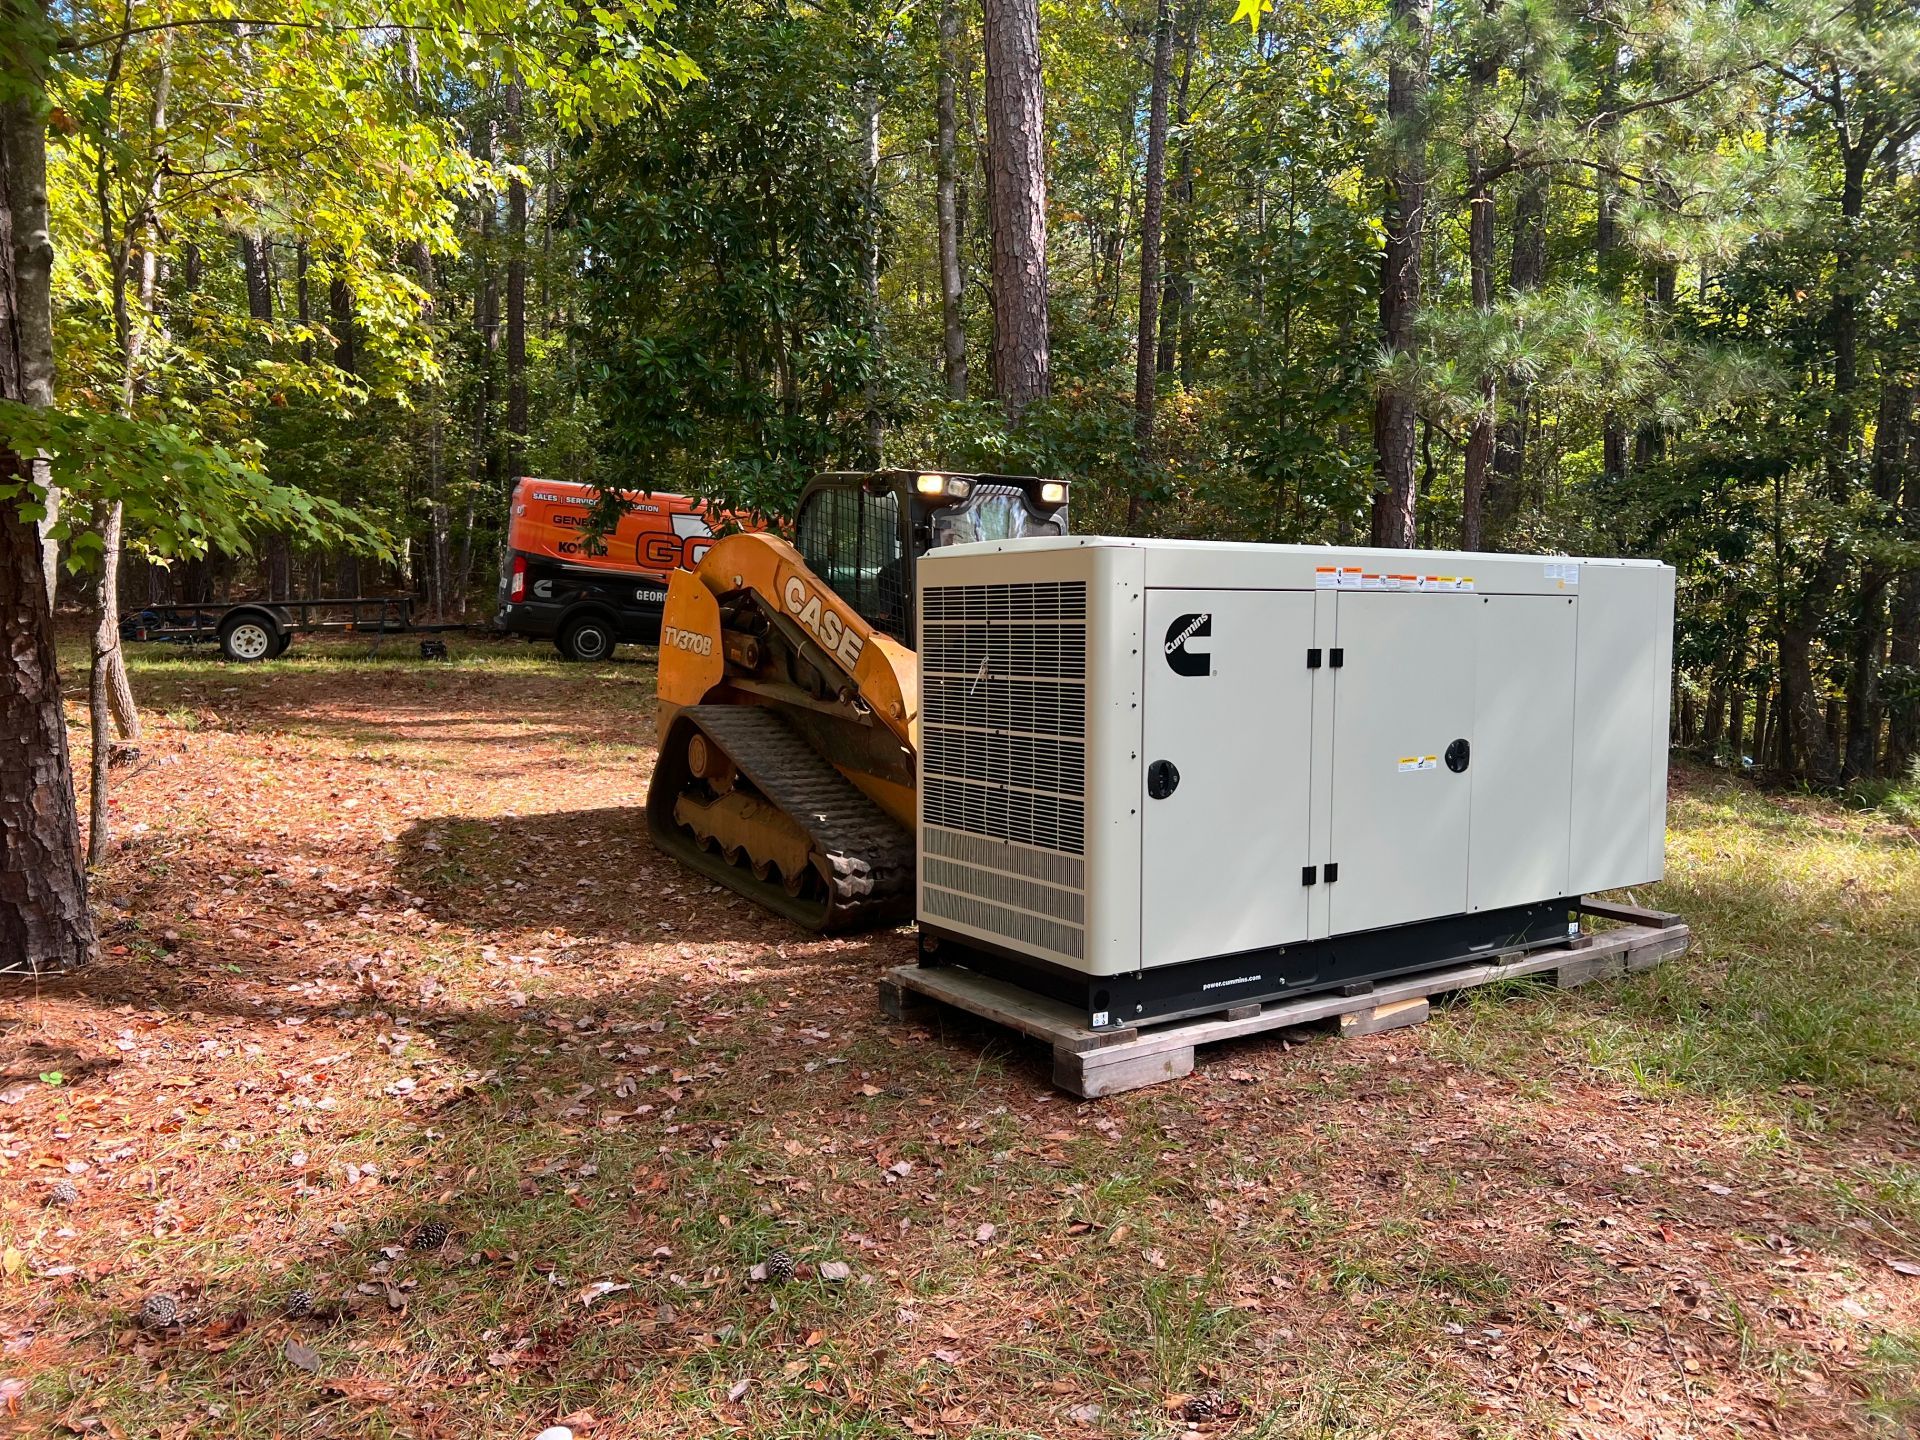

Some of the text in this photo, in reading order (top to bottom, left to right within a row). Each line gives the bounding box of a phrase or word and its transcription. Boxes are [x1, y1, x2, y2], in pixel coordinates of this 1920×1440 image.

[533, 493, 558, 502] SALES
[785, 576, 864, 671] CASE
[1164, 613, 1209, 655] Cummins
[665, 626, 712, 656] TV370B
[1202, 974, 1262, 991] power.cummins.com
